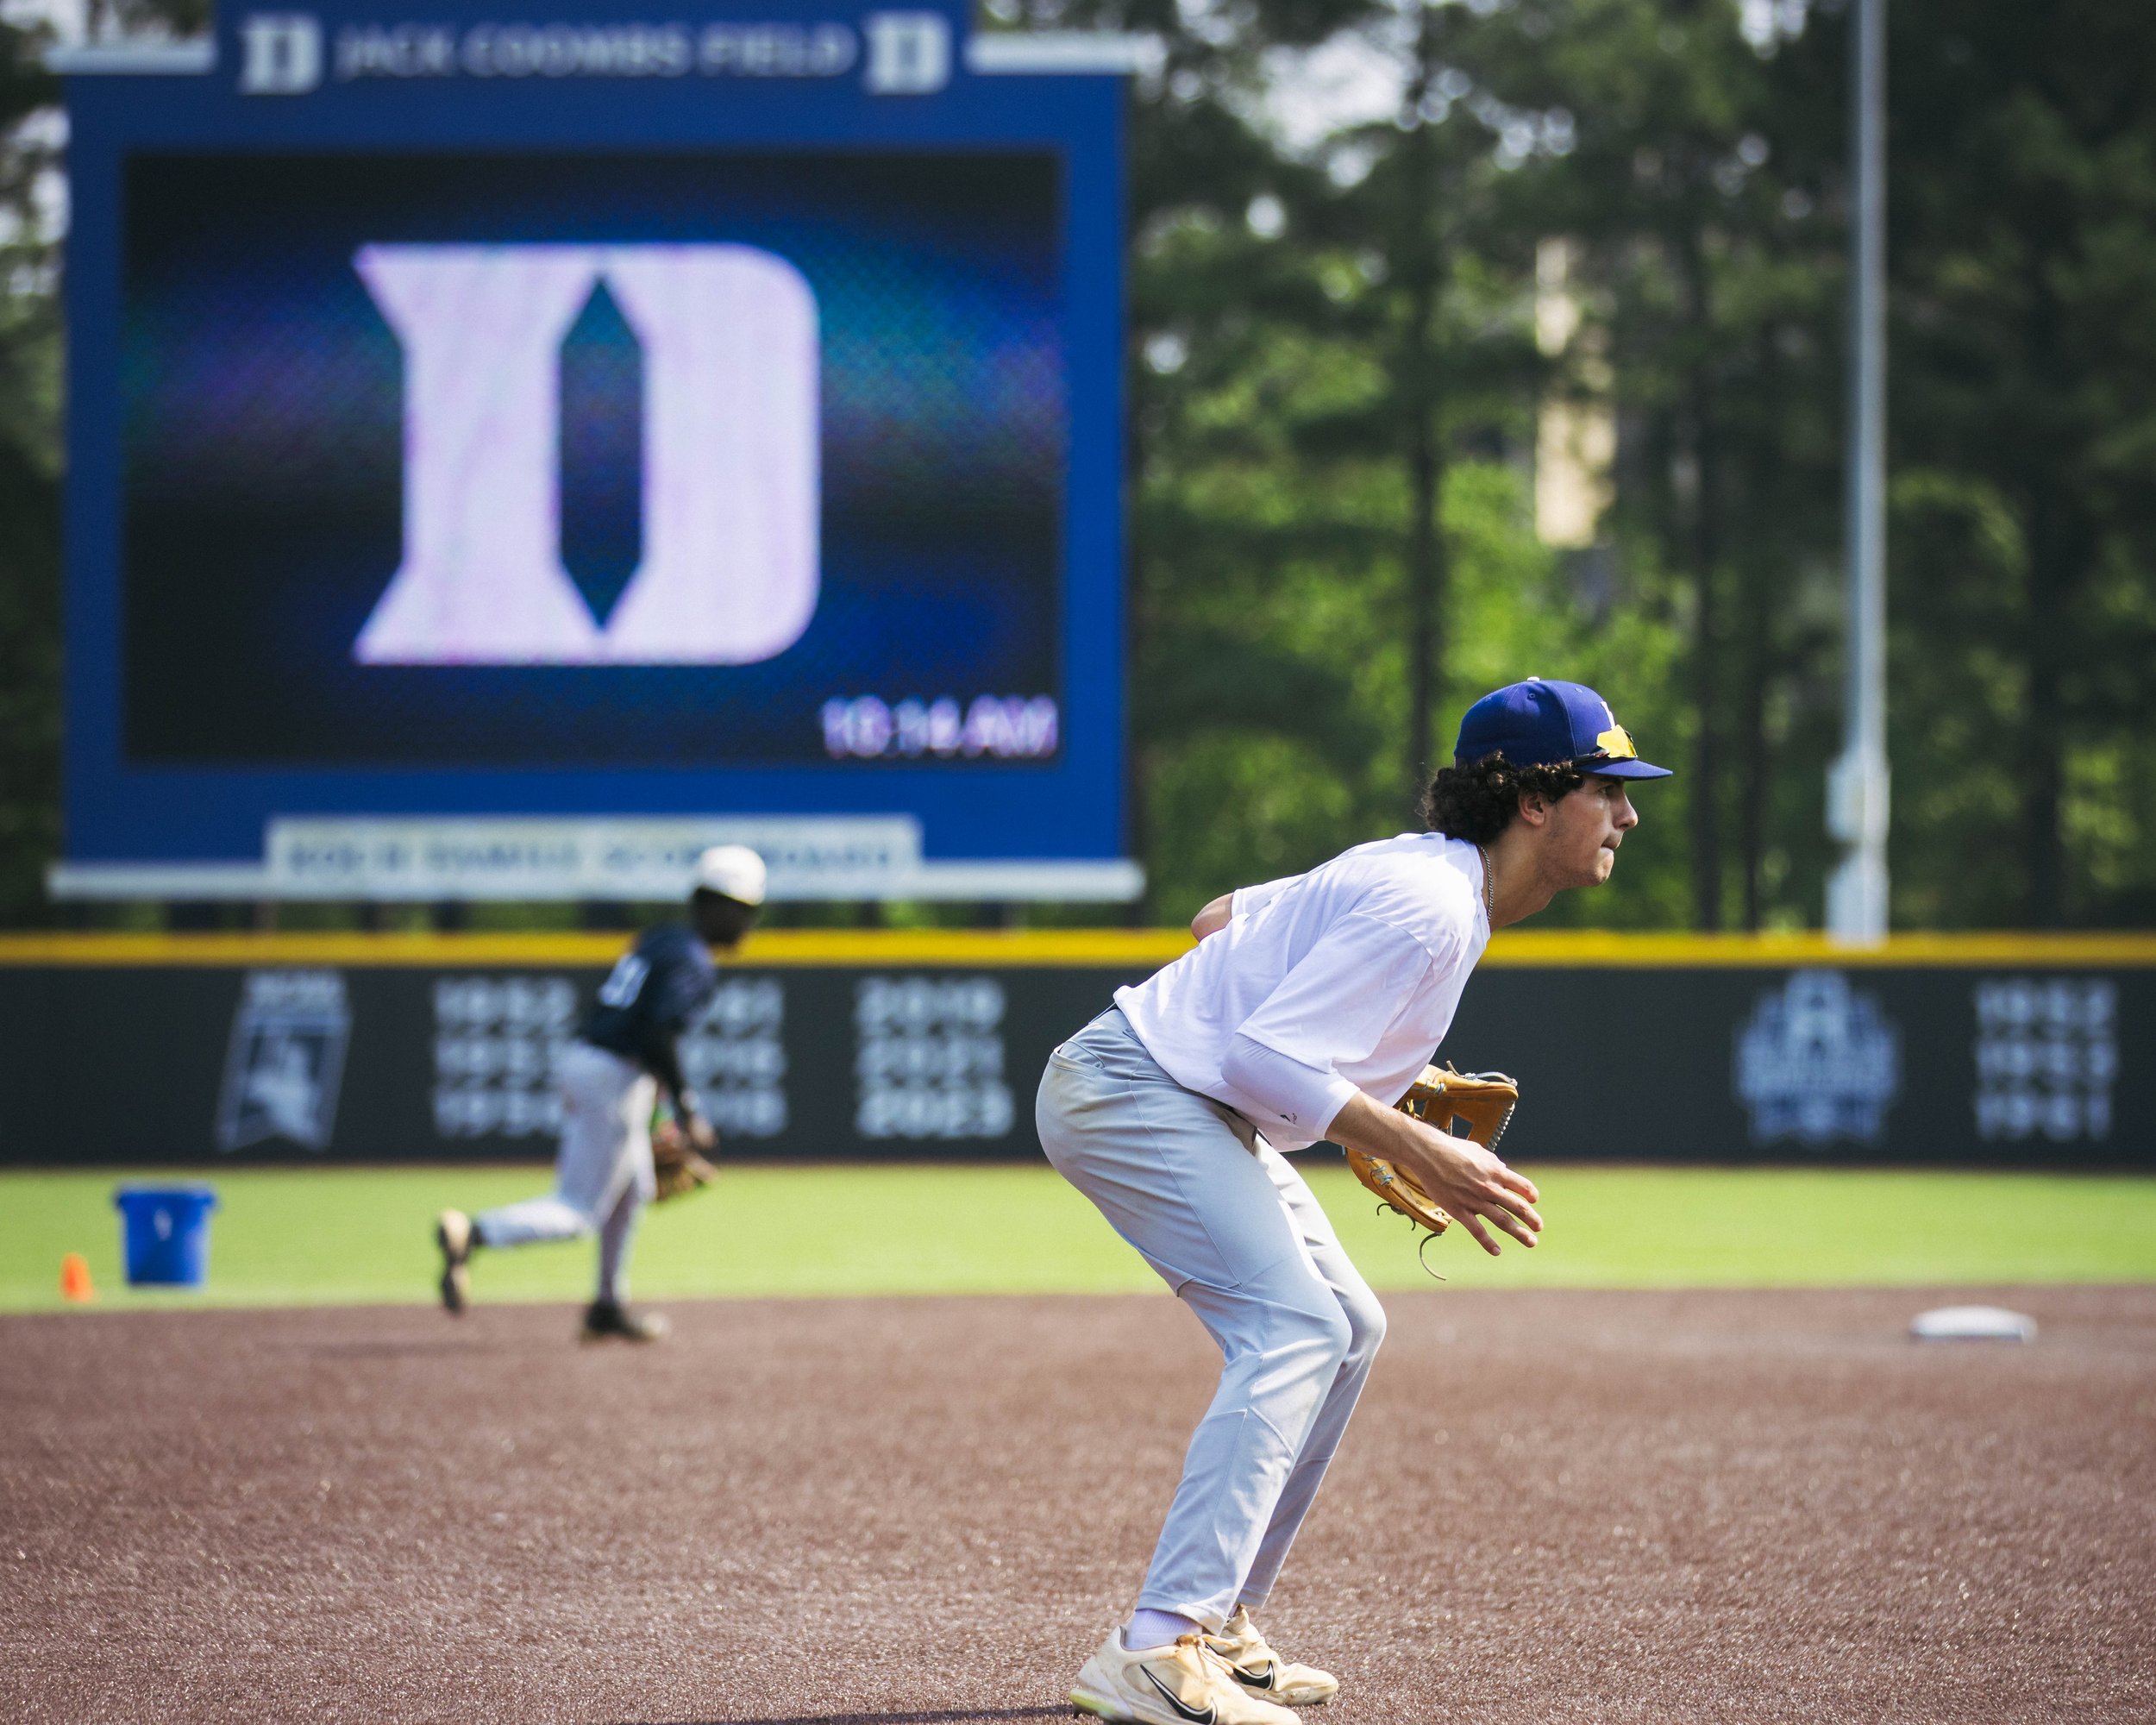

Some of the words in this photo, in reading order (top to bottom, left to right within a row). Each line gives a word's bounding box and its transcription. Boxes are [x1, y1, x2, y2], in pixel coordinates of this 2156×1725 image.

[241, 13, 321, 94] D
[339, 25, 456, 80] JACK
[465, 24, 689, 78] COOMBS
[701, 24, 856, 78] FIELD
[865, 12, 950, 95] D
[353, 243, 822, 667] D
